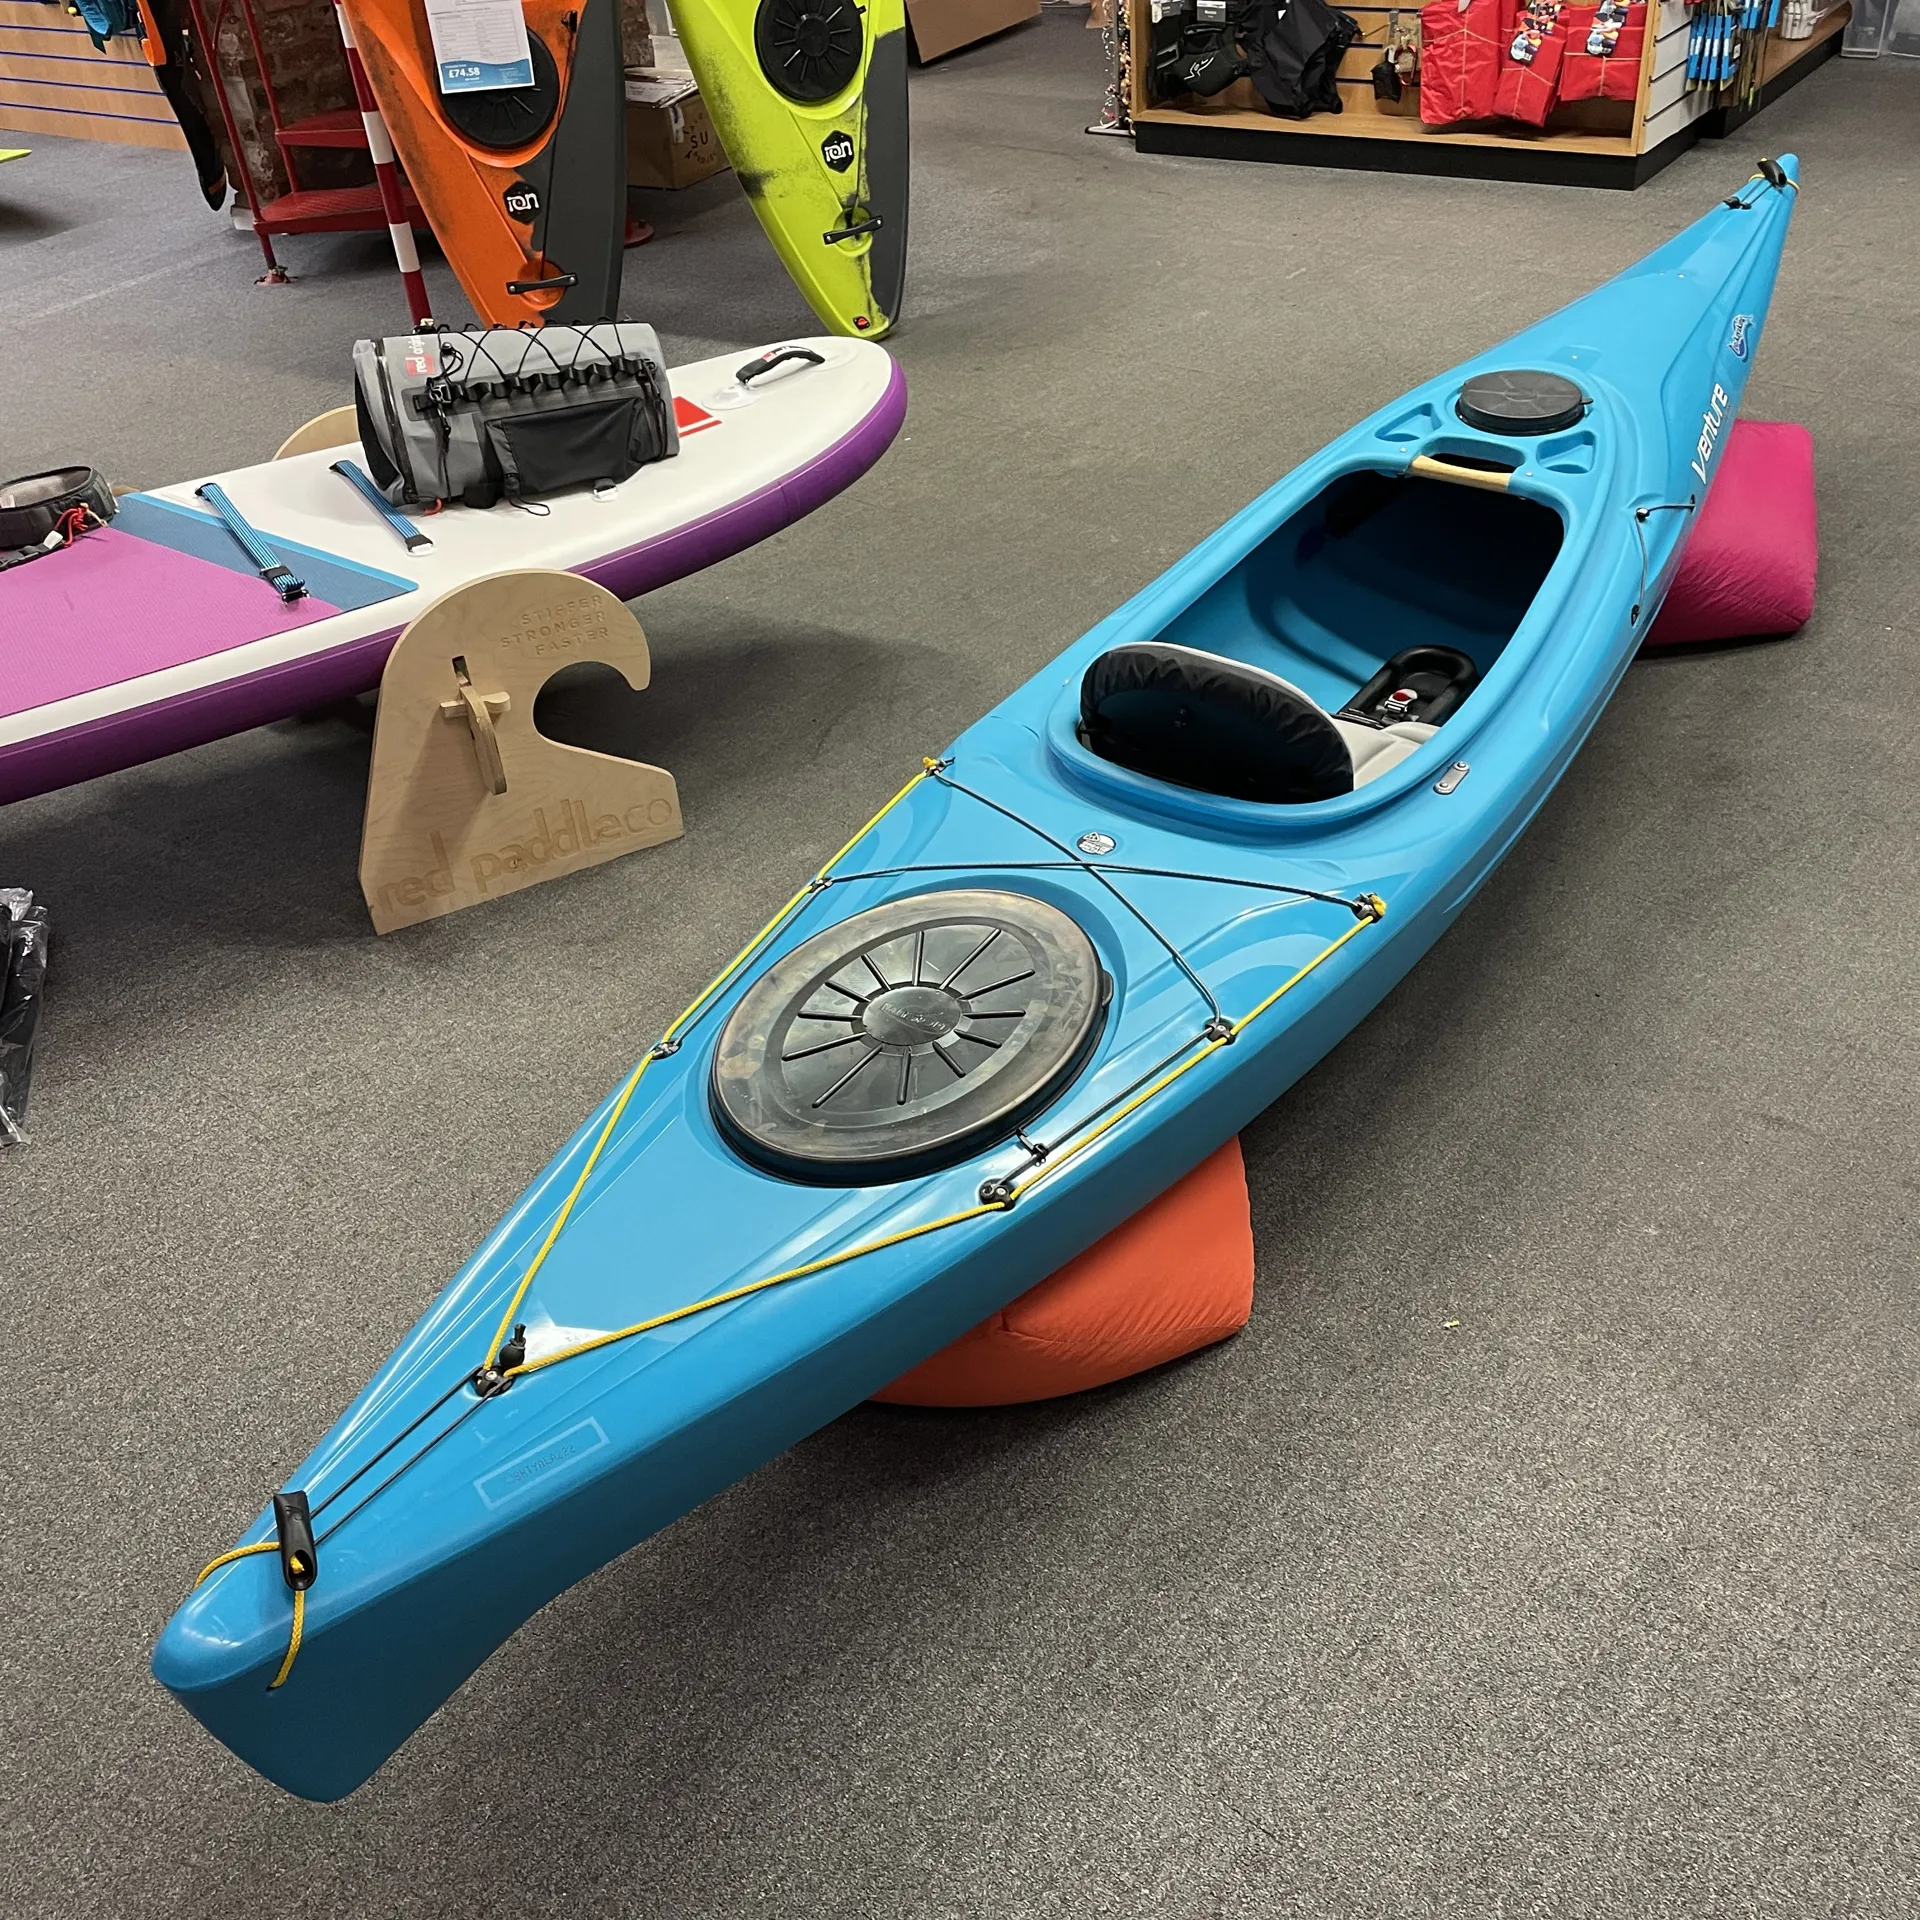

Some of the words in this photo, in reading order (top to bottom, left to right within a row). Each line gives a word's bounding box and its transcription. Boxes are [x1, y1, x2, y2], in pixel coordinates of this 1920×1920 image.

[405, 356, 427, 373] red
[1691, 382, 1729, 486] Venture
[521, 594, 603, 626] STIFFER
[500, 610, 606, 648] STRONGER
[534, 626, 609, 656] FASTER
[376, 831, 456, 914] red
